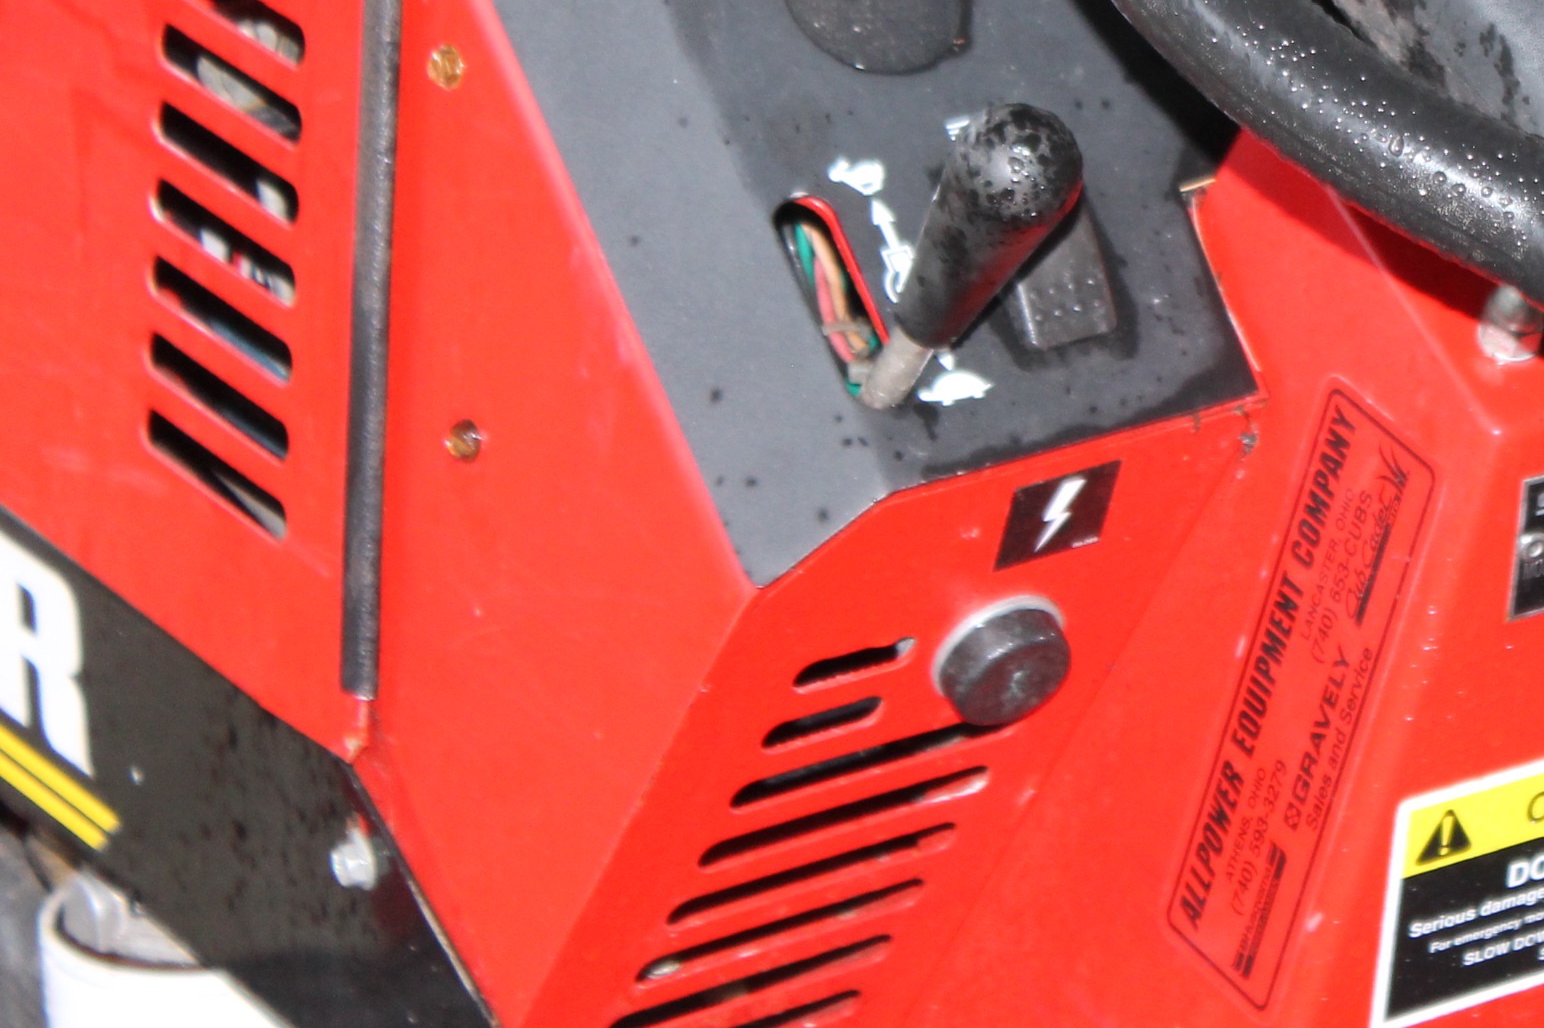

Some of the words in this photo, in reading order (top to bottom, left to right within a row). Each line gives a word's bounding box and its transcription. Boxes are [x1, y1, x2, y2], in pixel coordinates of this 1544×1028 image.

[1311, 607, 1338, 664] (740)
[1330, 489, 1373, 603] 653-CUBS
[1336, 488, 1355, 531] OHIO
[1345, 567, 1370, 620] Cub
[1362, 483, 1391, 570] Cadet
[1180, 760, 1244, 929] ALLPOWER
[1232, 570, 1305, 760] EQUIPMENT
[1292, 406, 1357, 570] COMPANY
[1292, 644, 1350, 804] GRAVELY
[1248, 768, 1266, 808] OHIO
[1306, 774, 1332, 831] Sales
[1328, 728, 1347, 769] and
[1340, 647, 1373, 726] Service
[1231, 861, 1258, 916] (740)
[1250, 759, 1287, 857] 593-3279
[1408, 909, 1477, 938] Serious
[1428, 939, 1452, 954] For
[1454, 918, 1523, 946] emergency
[1462, 942, 1511, 967] SLOW
